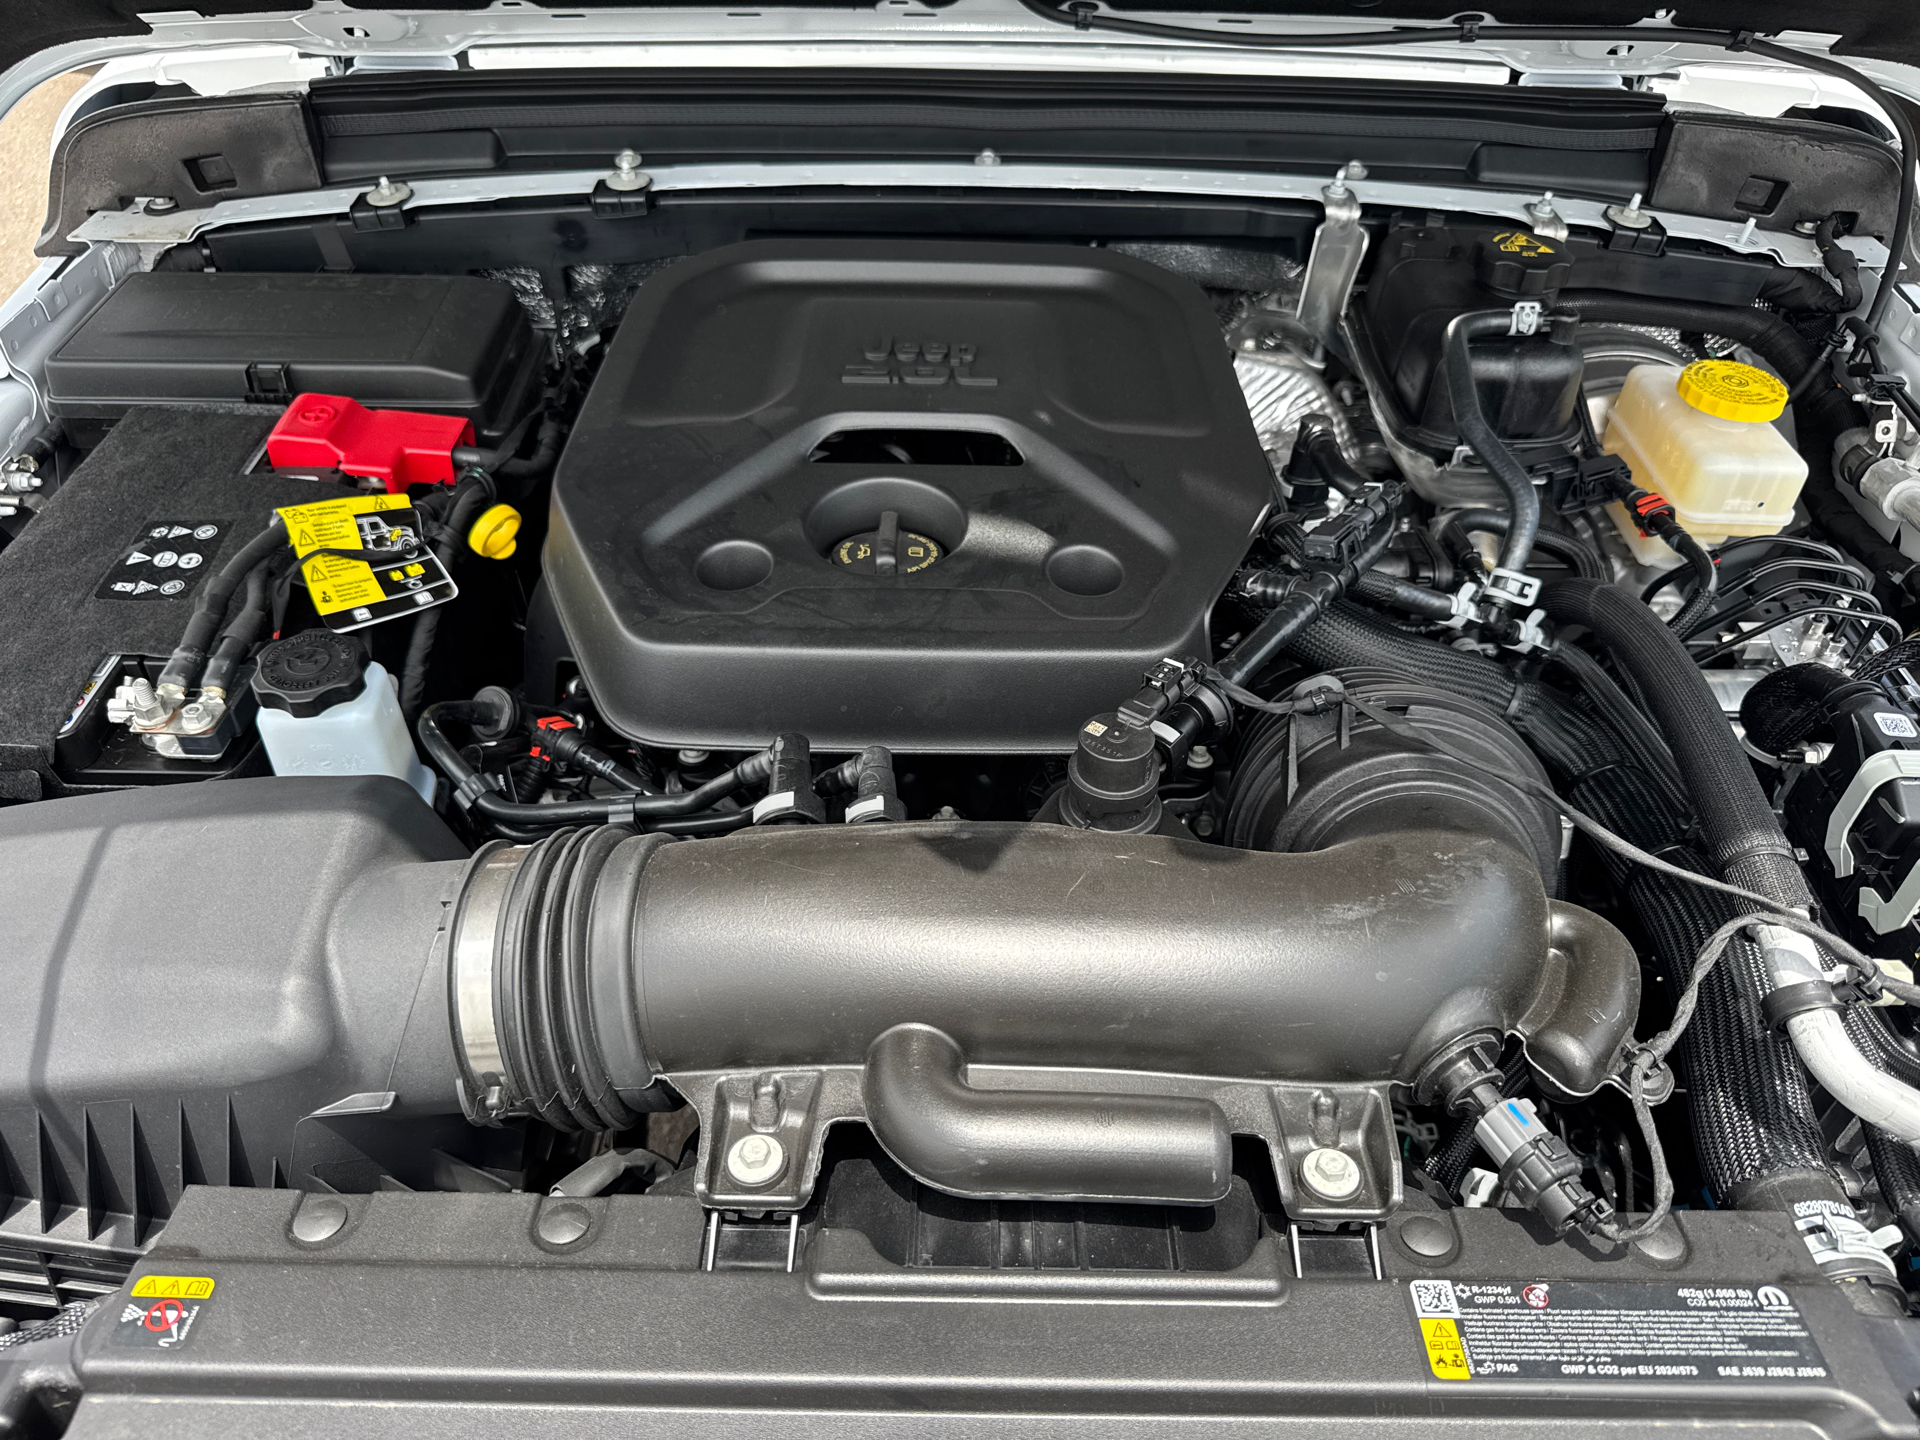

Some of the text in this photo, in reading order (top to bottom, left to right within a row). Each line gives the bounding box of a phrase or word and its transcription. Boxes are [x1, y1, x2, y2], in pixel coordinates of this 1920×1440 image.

[863, 337, 977, 366] Jeep
[841, 364, 998, 386] 2.0L
[1496, 1363, 1518, 1373] PAG
